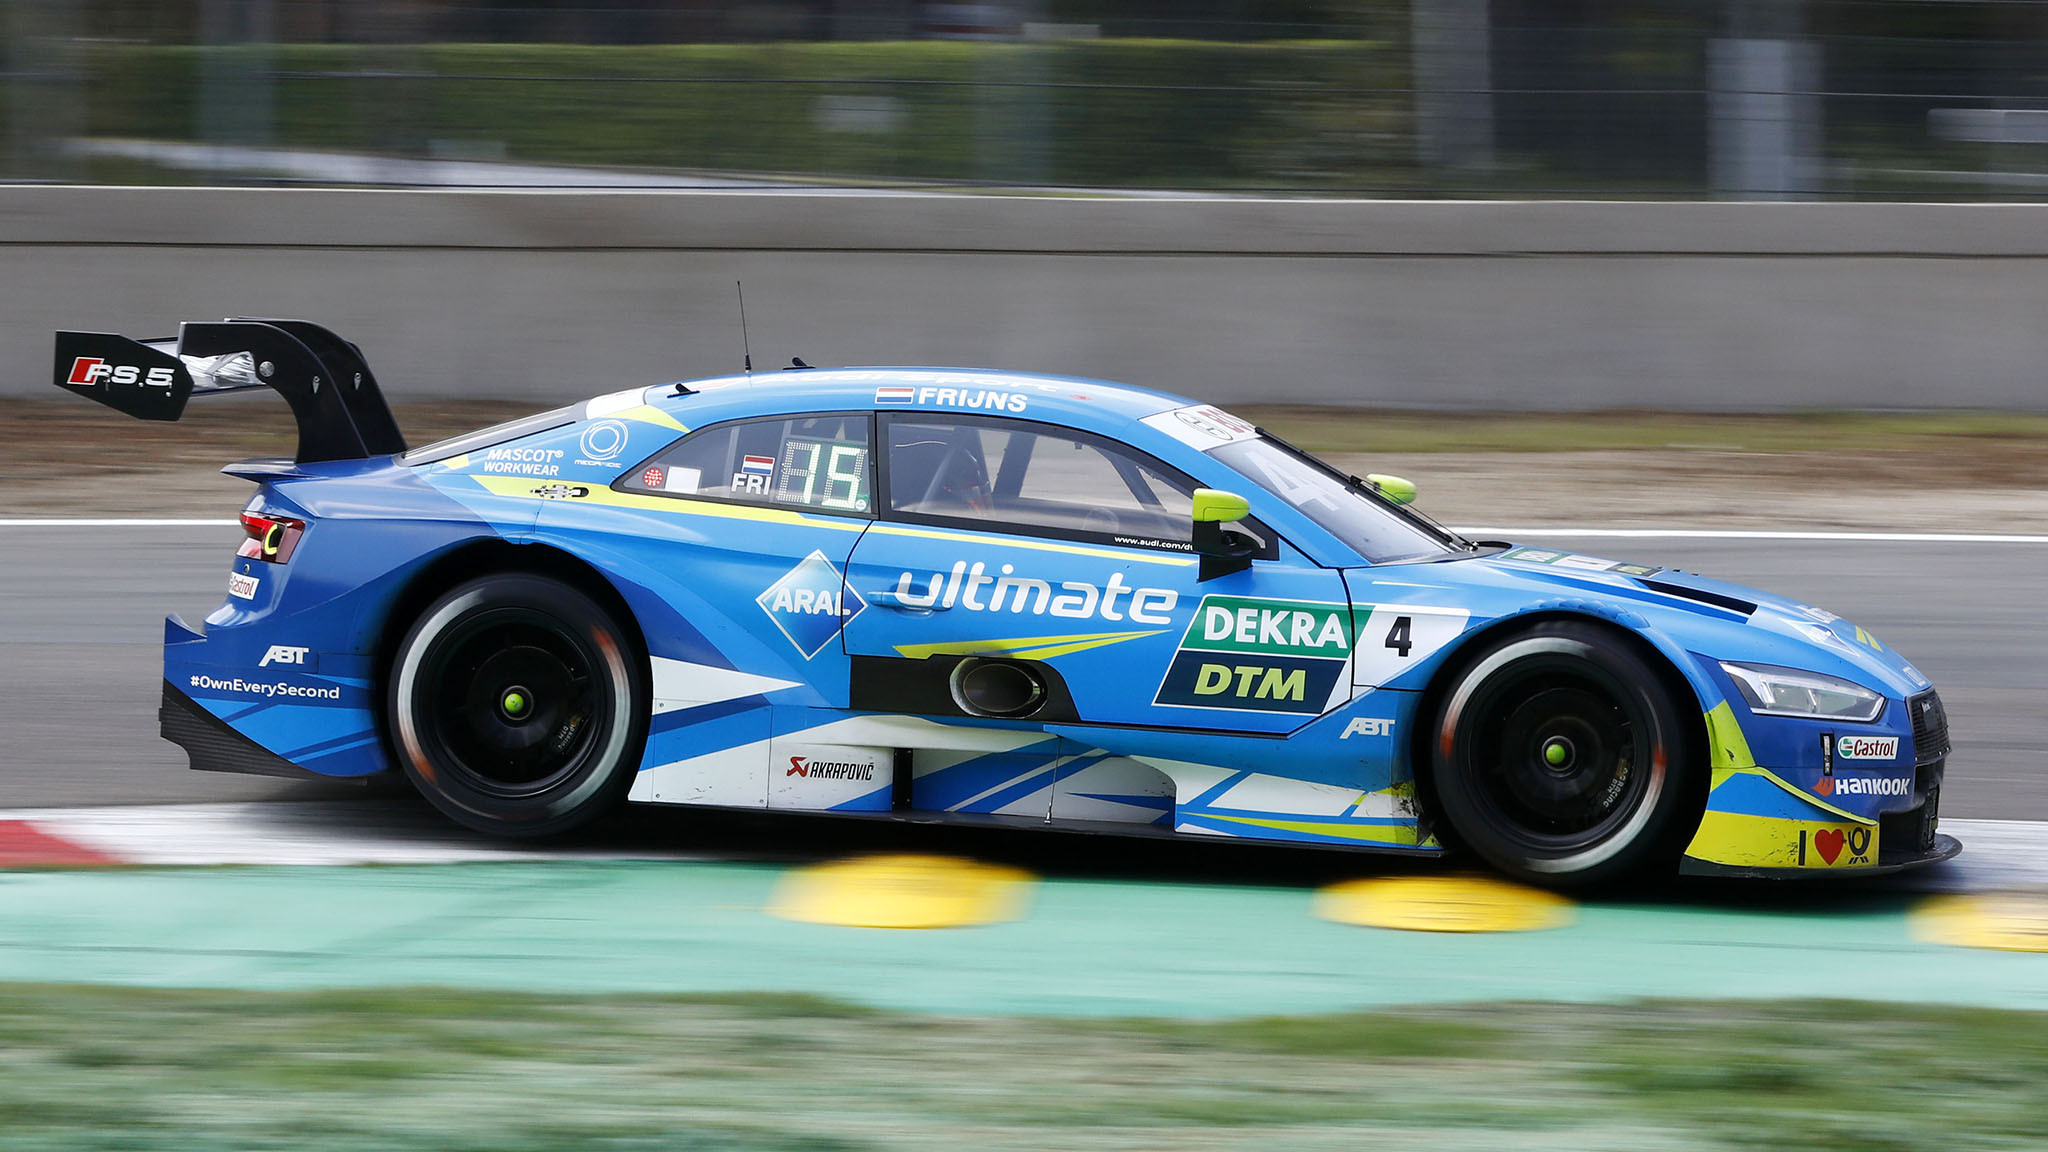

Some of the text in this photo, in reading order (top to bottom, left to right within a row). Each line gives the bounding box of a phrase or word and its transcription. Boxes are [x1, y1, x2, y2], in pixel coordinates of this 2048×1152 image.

[918, 387, 1028, 413] FRIJNS
[484, 461, 560, 476] WORKWEAR
[731, 472, 772, 496] FRI
[771, 587, 851, 617] ARAL
[894, 560, 1179, 625] ultimate
[1203, 606, 1348, 649] DEKRA
[1384, 616, 1413, 658] 4
[258, 644, 310, 667] ABT
[190, 674, 341, 700] #OwnEverySecond
[1193, 663, 1307, 702] DTM
[1339, 716, 1396, 739] ABT
[1853, 738, 1895, 757] Castrol
